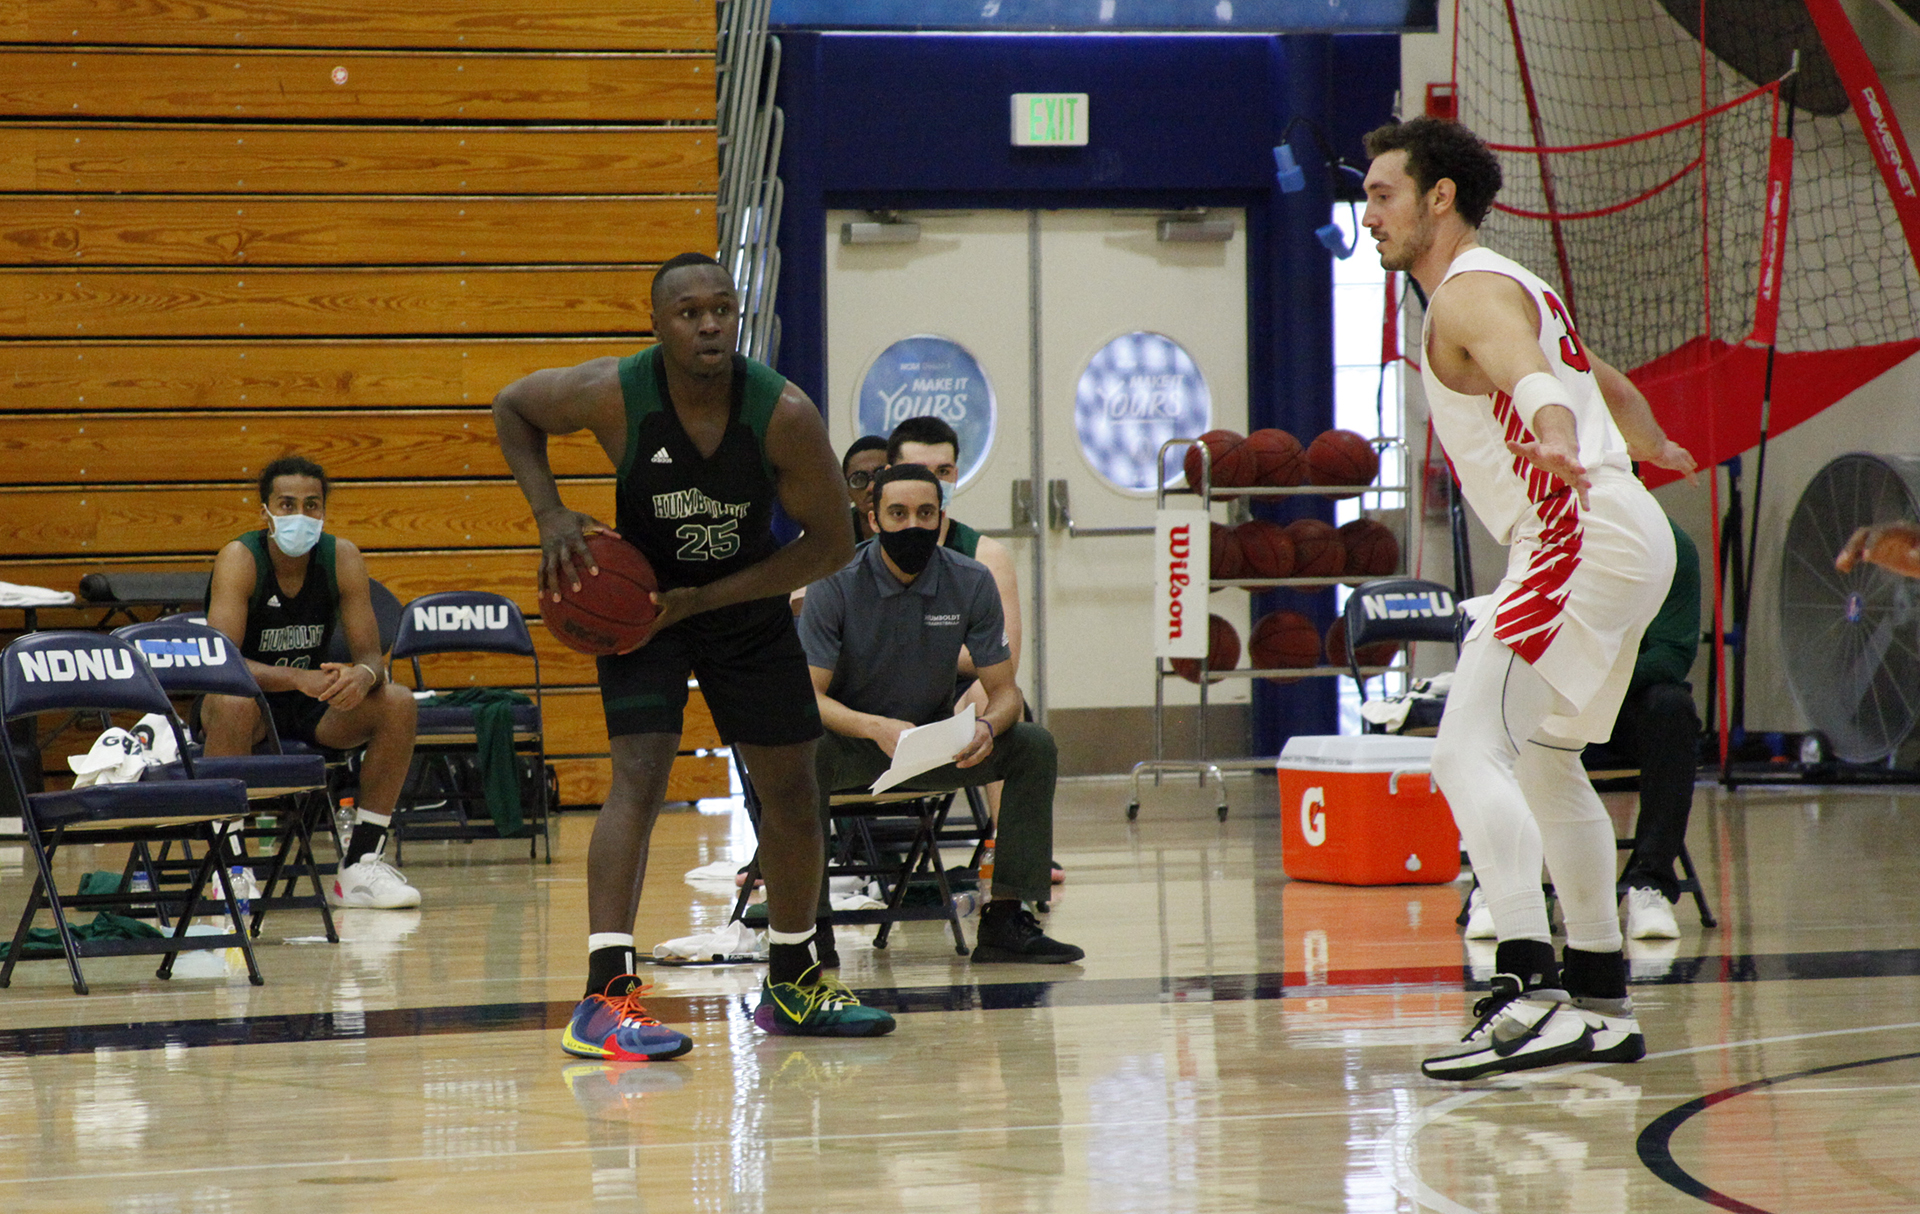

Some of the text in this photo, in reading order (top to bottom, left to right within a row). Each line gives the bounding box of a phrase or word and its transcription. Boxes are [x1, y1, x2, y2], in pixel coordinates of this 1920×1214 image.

[1029, 97, 1079, 141] EXIT
[912, 377, 969, 391] MAKE IT
[878, 383, 968, 432] YOURS
[676, 518, 740, 561] 25
[1169, 523, 1190, 640] Wilson
[258, 625, 325, 652] HUMBOLDT
[414, 604, 509, 631] NDNU
[17, 648, 135, 682] NDNU
[1301, 786, 1326, 847] G
